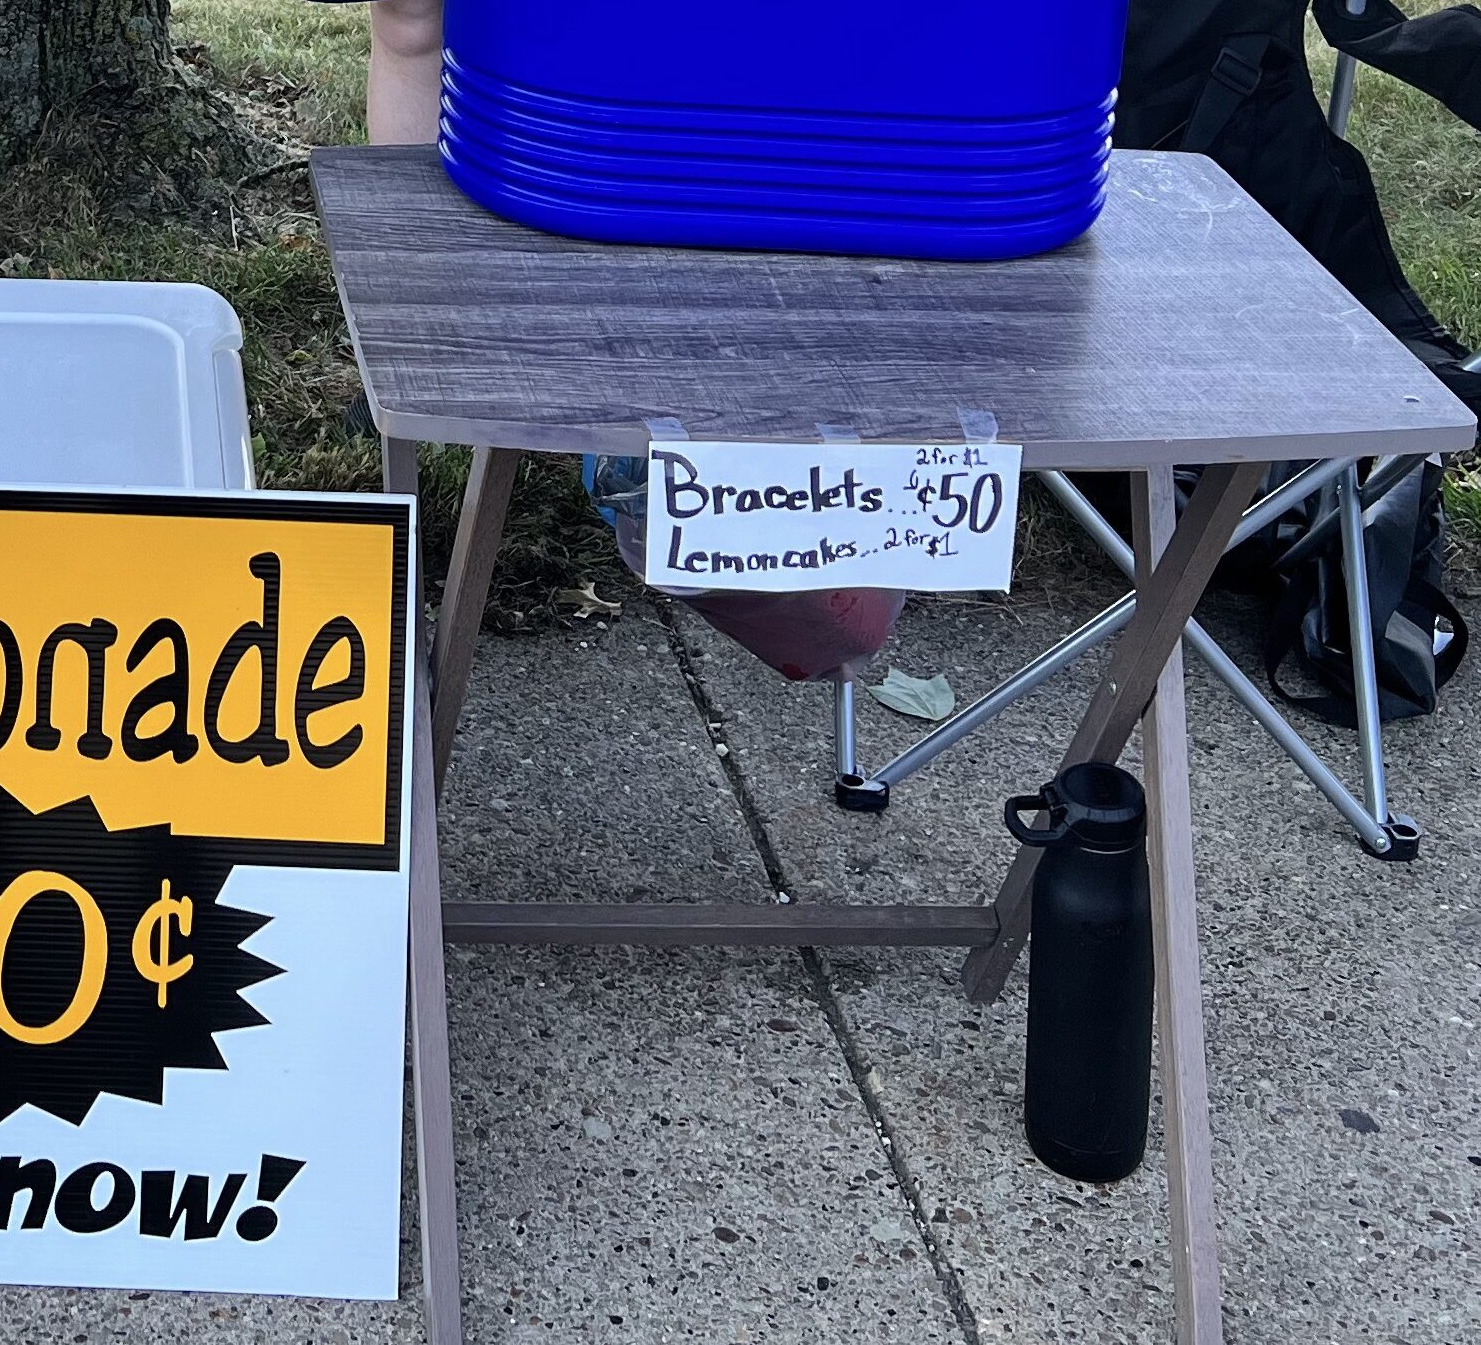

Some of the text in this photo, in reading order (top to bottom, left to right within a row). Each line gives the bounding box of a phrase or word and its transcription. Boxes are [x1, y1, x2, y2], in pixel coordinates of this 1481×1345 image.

[916, 448, 930, 466] 2
[932, 447, 958, 466] for
[884, 527, 901, 551] 2
[904, 528, 930, 547] for
[925, 530, 959, 560] $1
